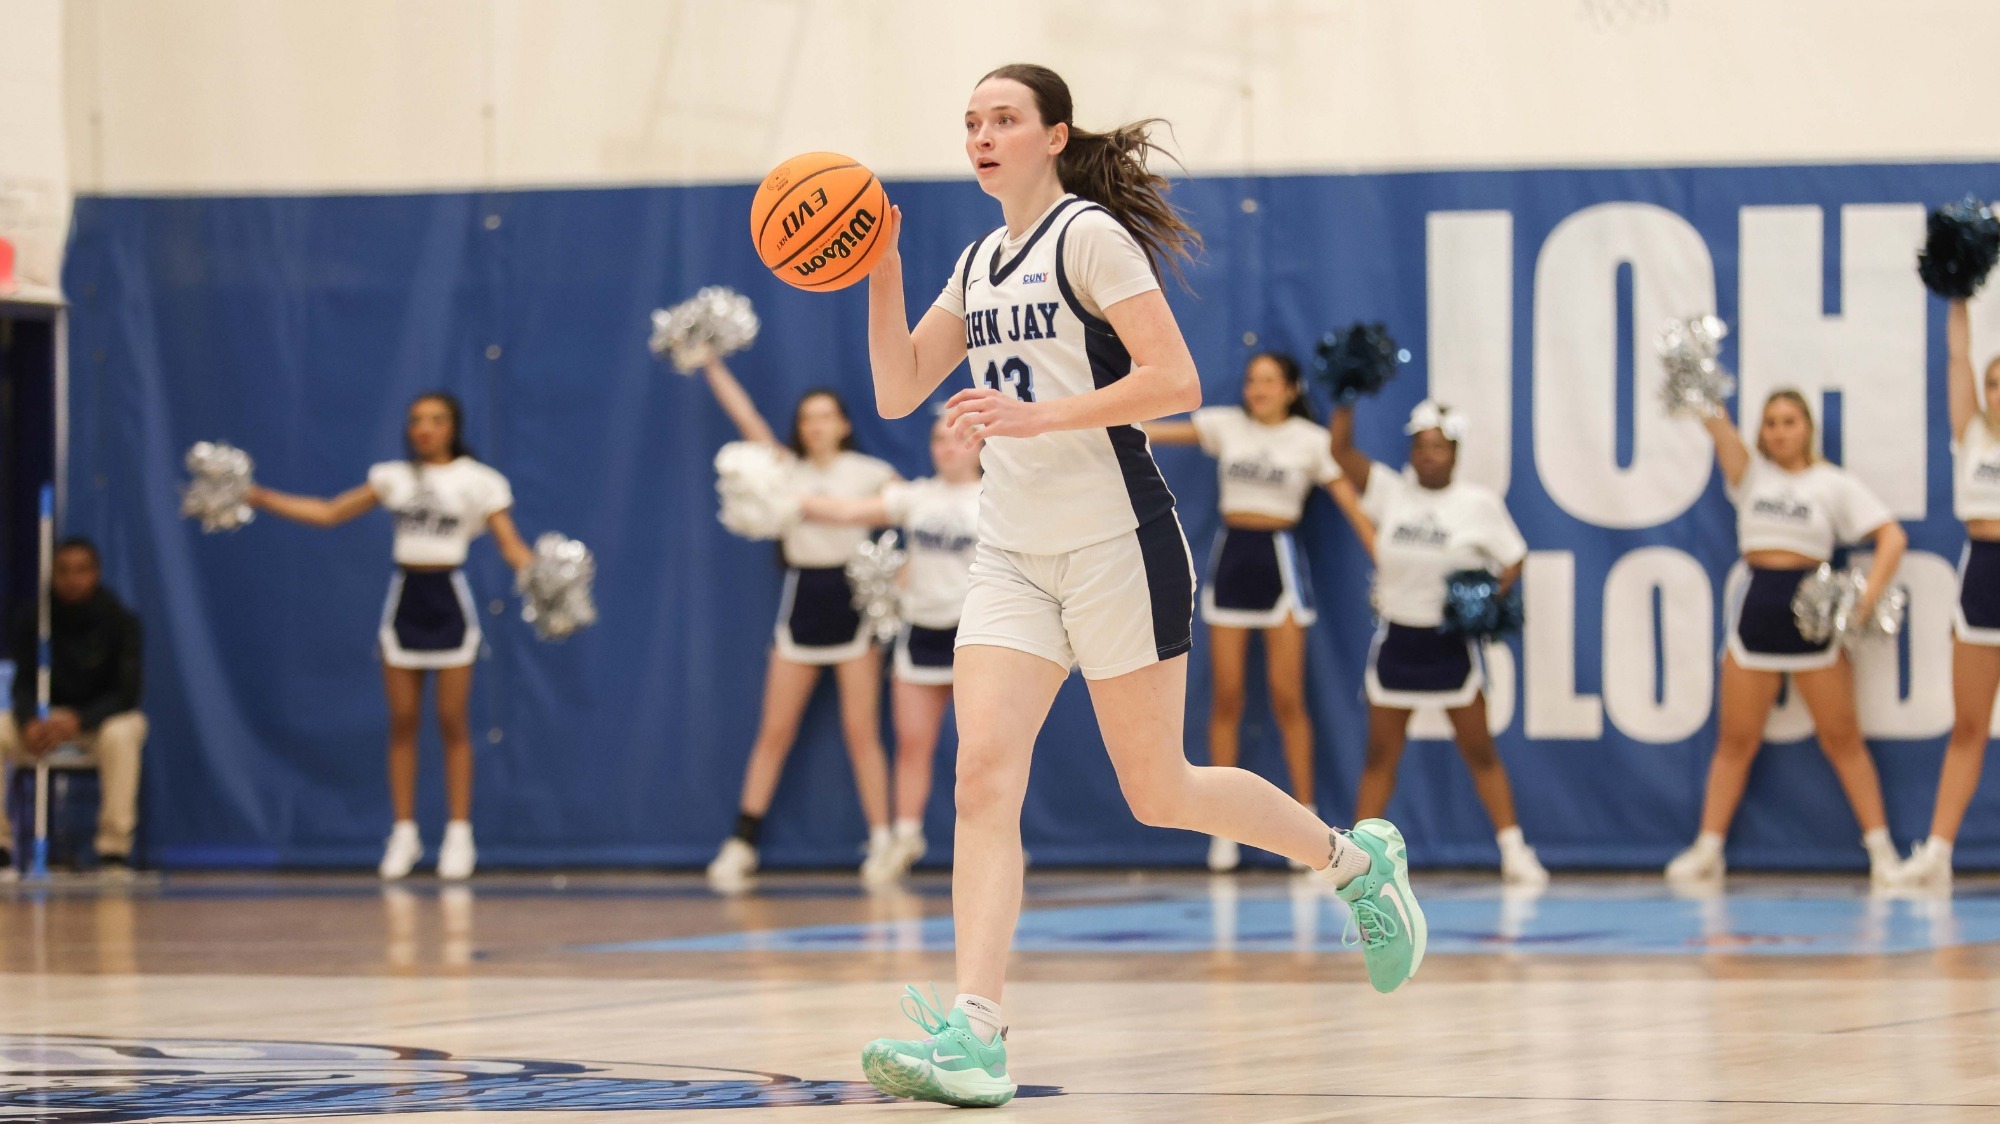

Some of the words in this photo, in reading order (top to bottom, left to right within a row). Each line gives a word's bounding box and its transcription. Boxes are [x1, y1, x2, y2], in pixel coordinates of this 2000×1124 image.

[782, 187, 828, 238] EVO
[793, 208, 877, 276] Wilson
[1023, 272, 1049, 284] CUNY
[1007, 302, 1059, 341] JAY
[1425, 201, 2000, 529] JOH
